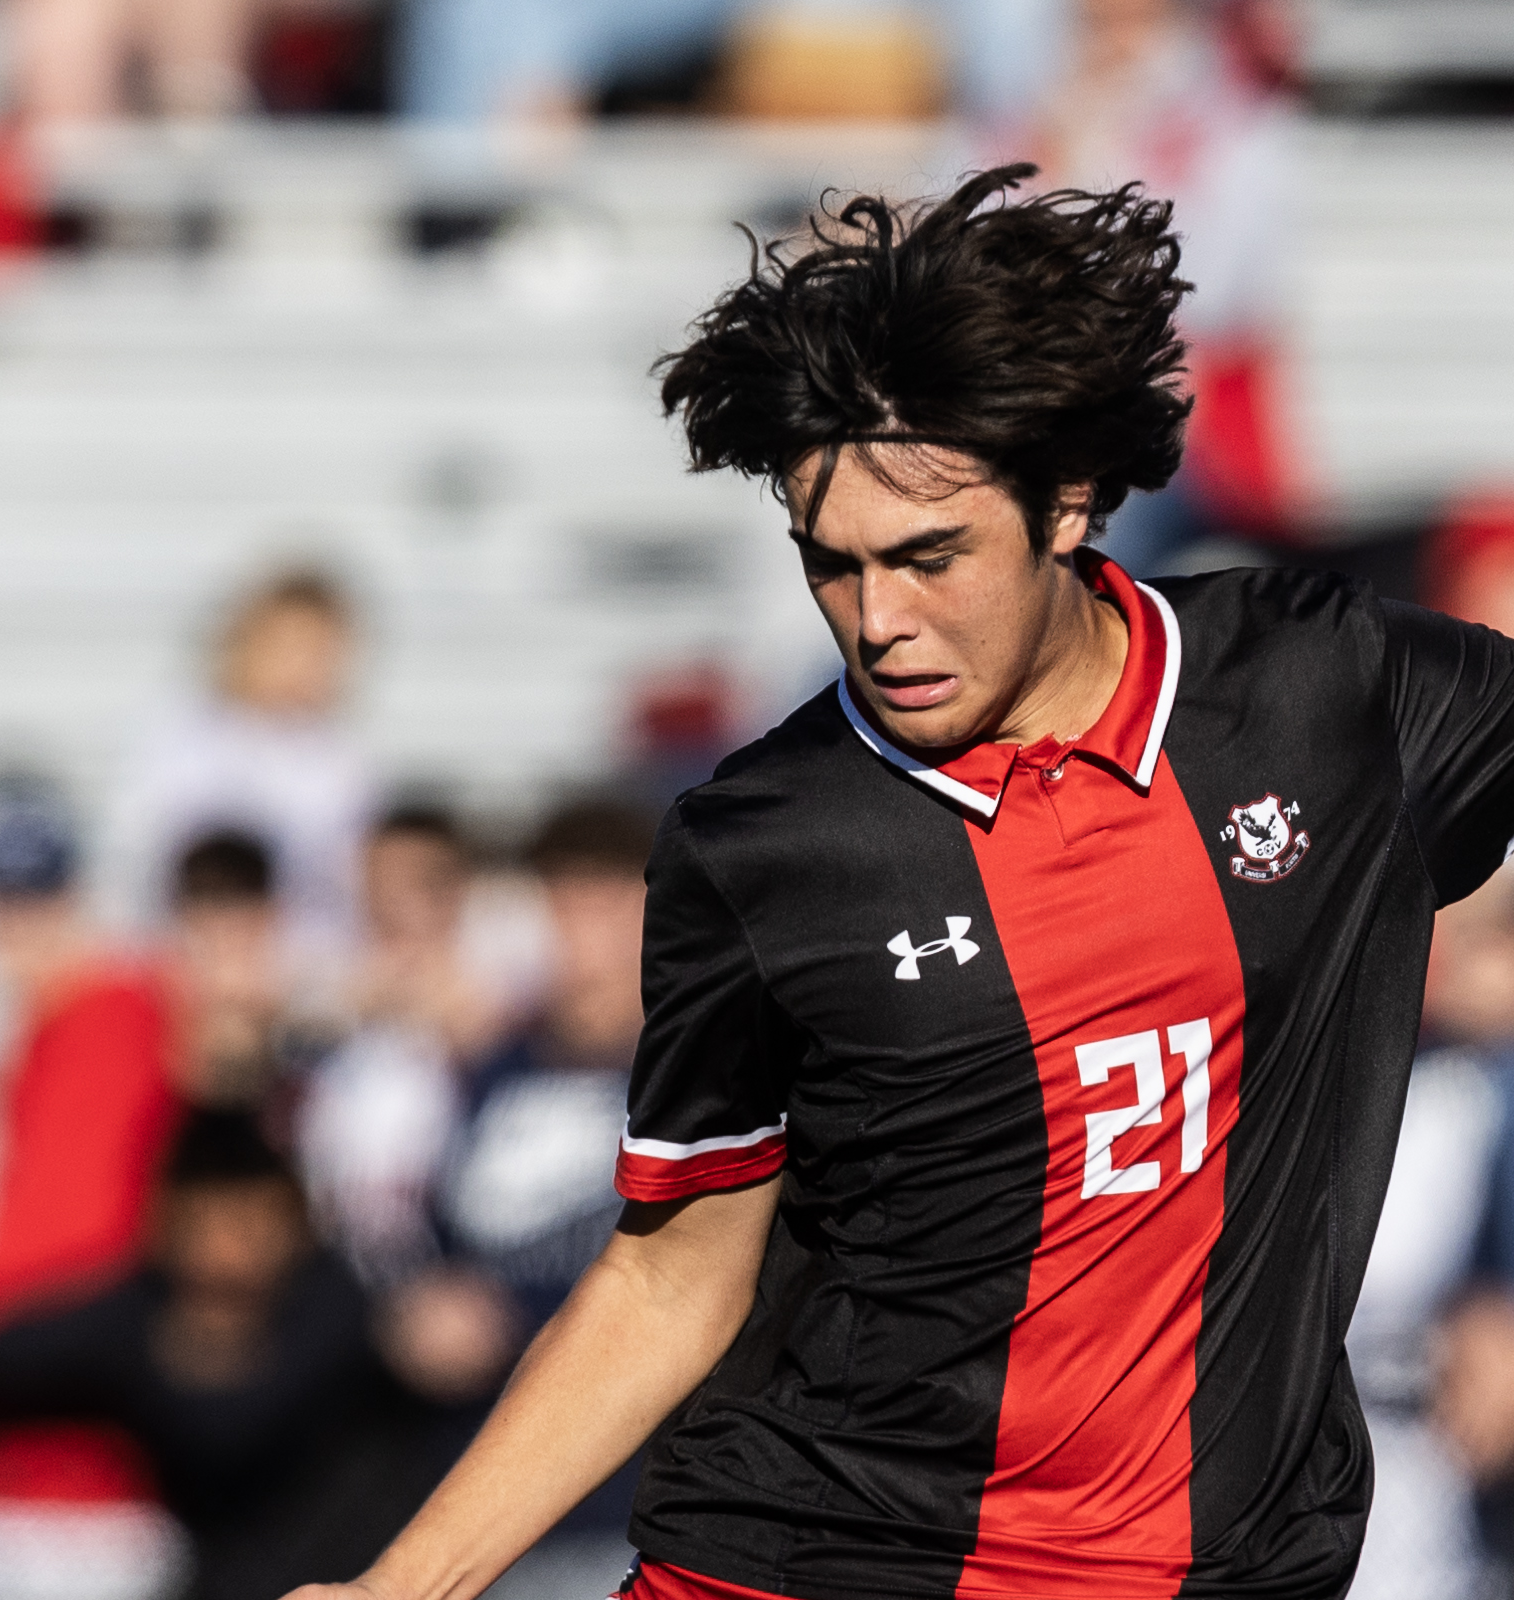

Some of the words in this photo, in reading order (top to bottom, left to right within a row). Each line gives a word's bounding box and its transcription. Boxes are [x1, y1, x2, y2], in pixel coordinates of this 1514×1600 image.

[1219, 824, 1236, 842] 19
[1282, 800, 1301, 822] 74
[1074, 1017, 1213, 1200] 21
